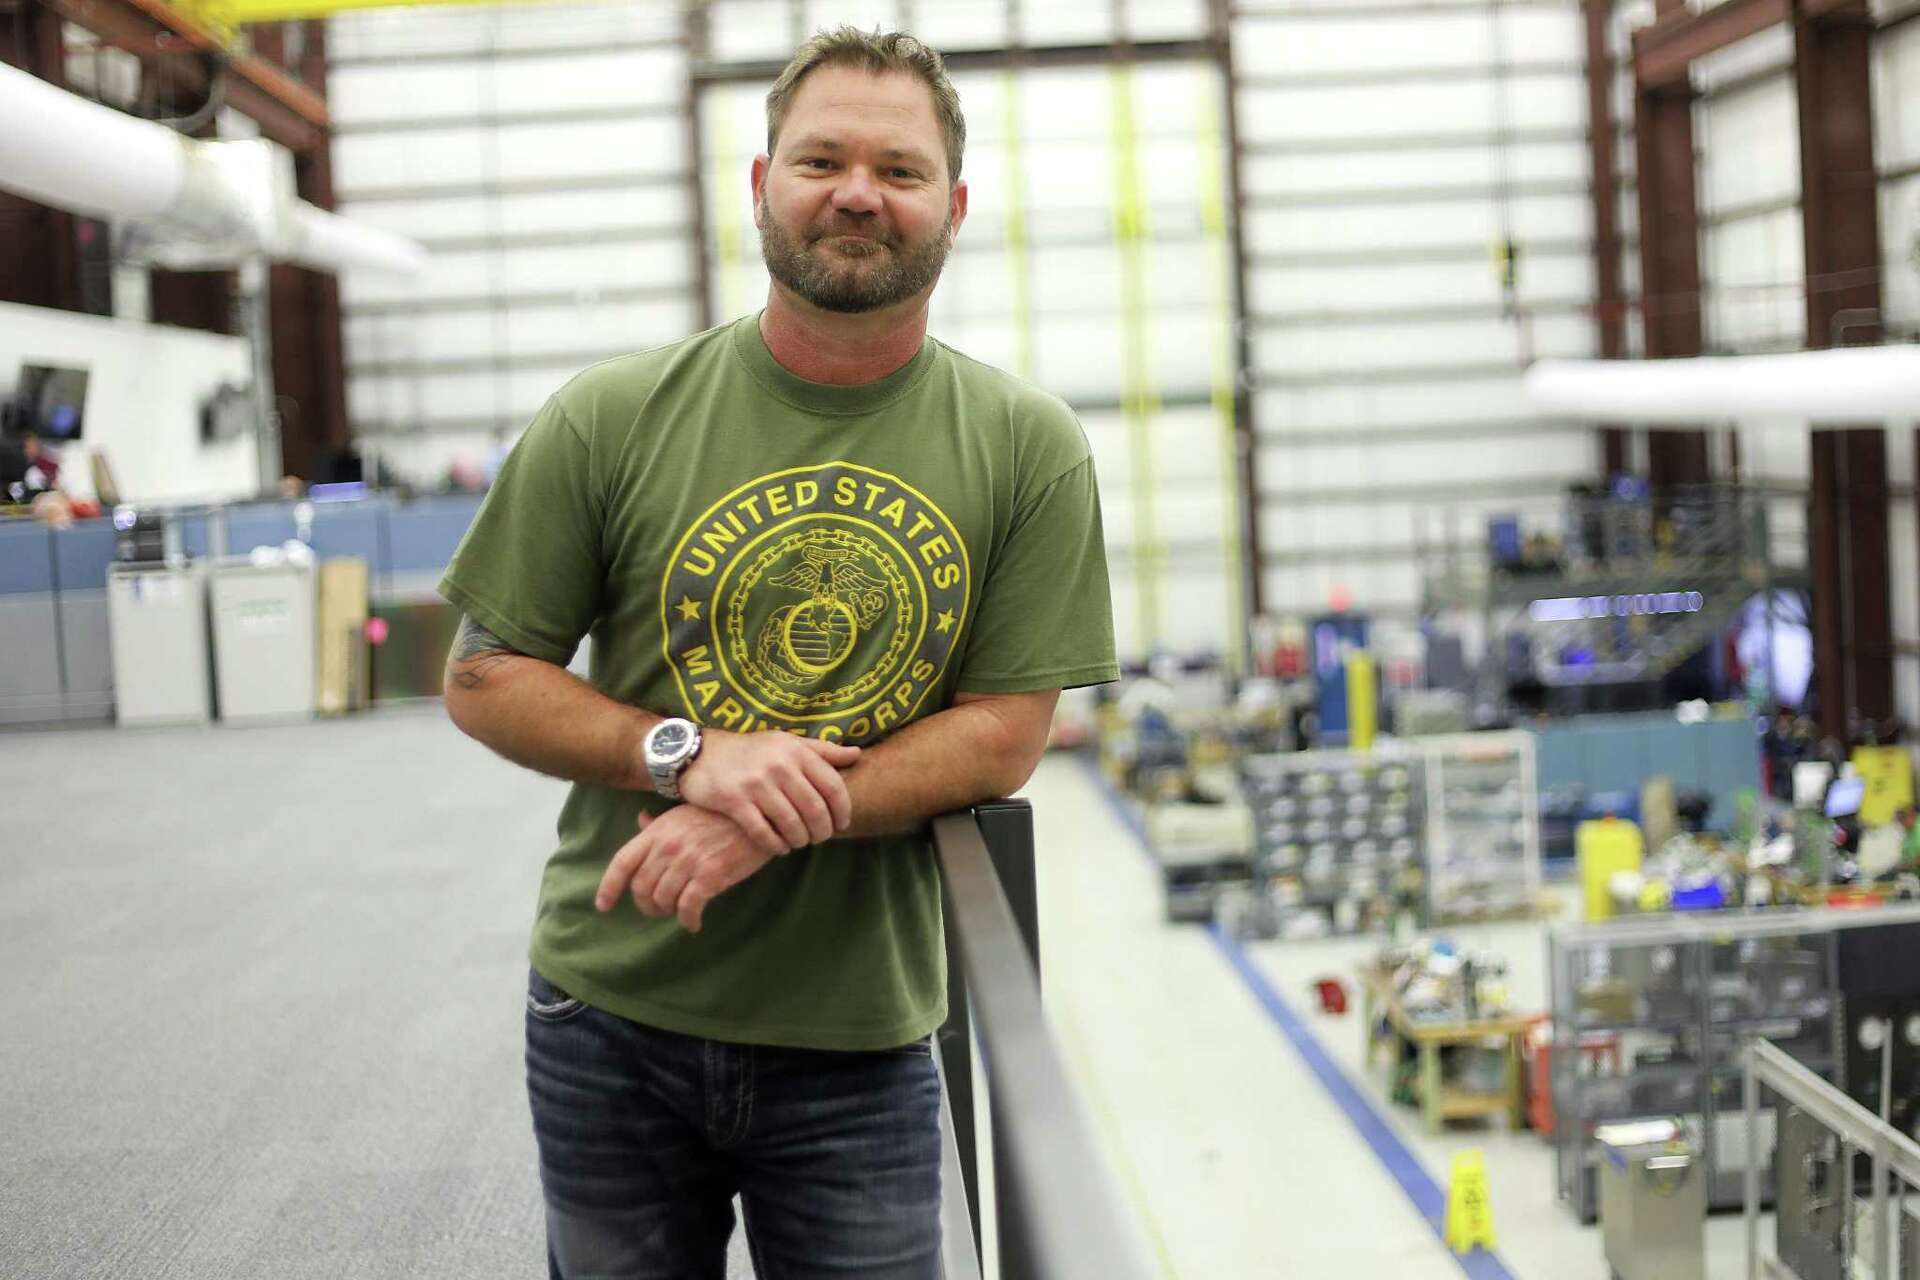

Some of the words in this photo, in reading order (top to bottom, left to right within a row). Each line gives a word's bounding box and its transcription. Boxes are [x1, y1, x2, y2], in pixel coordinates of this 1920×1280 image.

[682, 480, 819, 577] UNITED
[833, 476, 960, 589] STATES
[682, 644, 807, 736] MARI
[818, 658, 935, 744] CORPS
